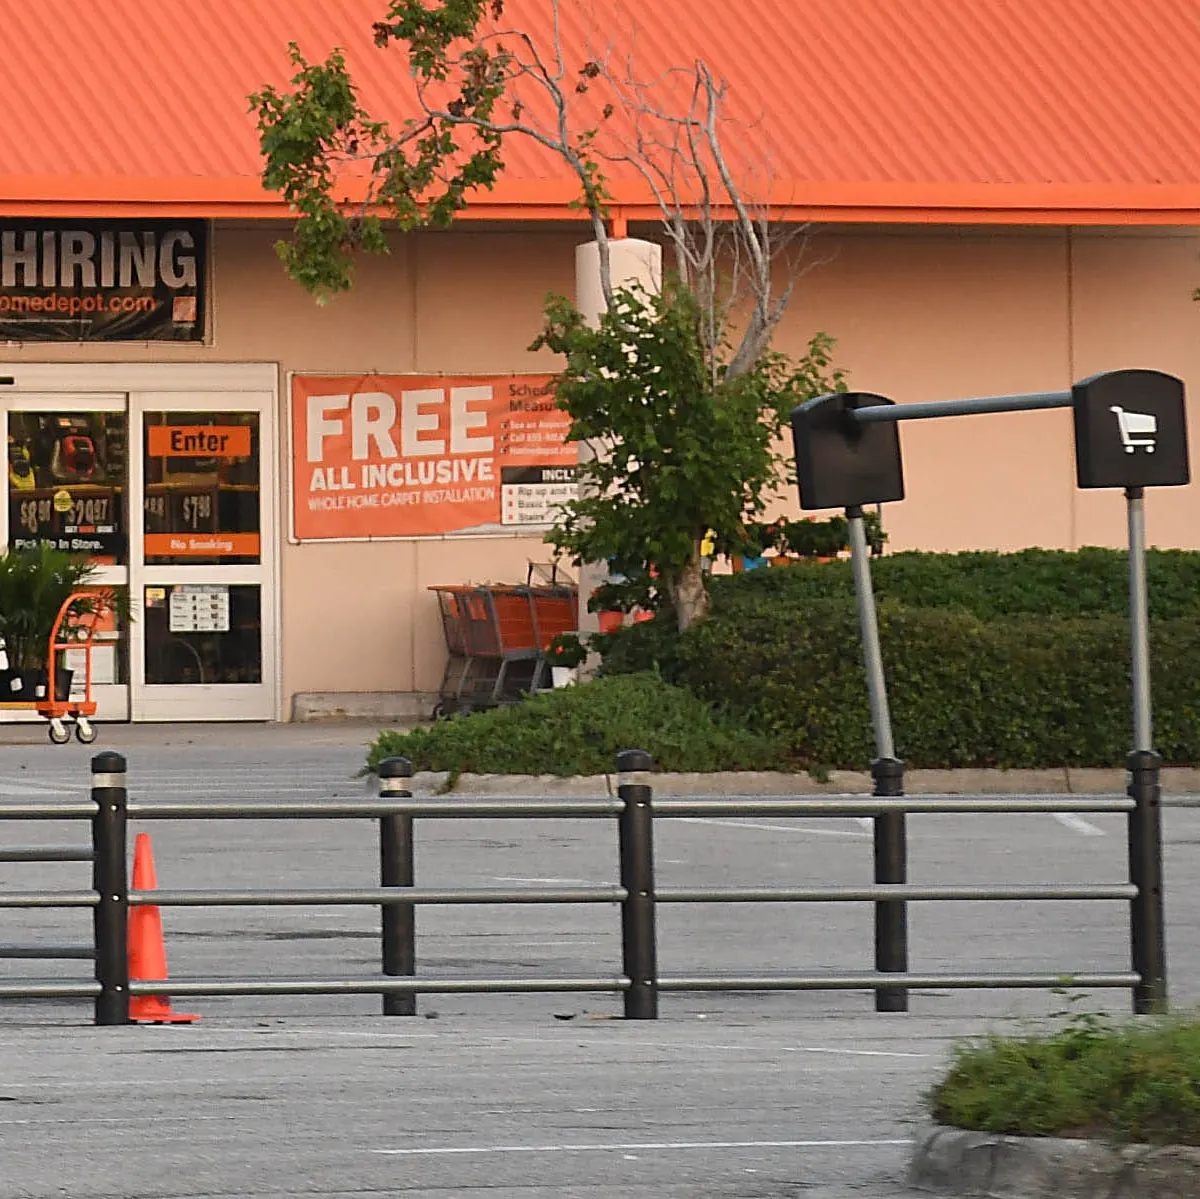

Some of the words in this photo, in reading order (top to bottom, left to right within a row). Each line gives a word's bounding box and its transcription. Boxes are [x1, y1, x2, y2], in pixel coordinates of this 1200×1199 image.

[2, 230, 196, 289] HIRING
[509, 384, 554, 396] Sched
[306, 385, 495, 462] FREE
[171, 430, 228, 452] Enter
[310, 466, 356, 492] ALL
[362, 457, 495, 487] INCLUSIVE
[308, 495, 344, 511] WHOLE
[346, 493, 380, 510] HOME
[381, 490, 421, 508] CARPET
[422, 486, 495, 505] INSTALLATION
